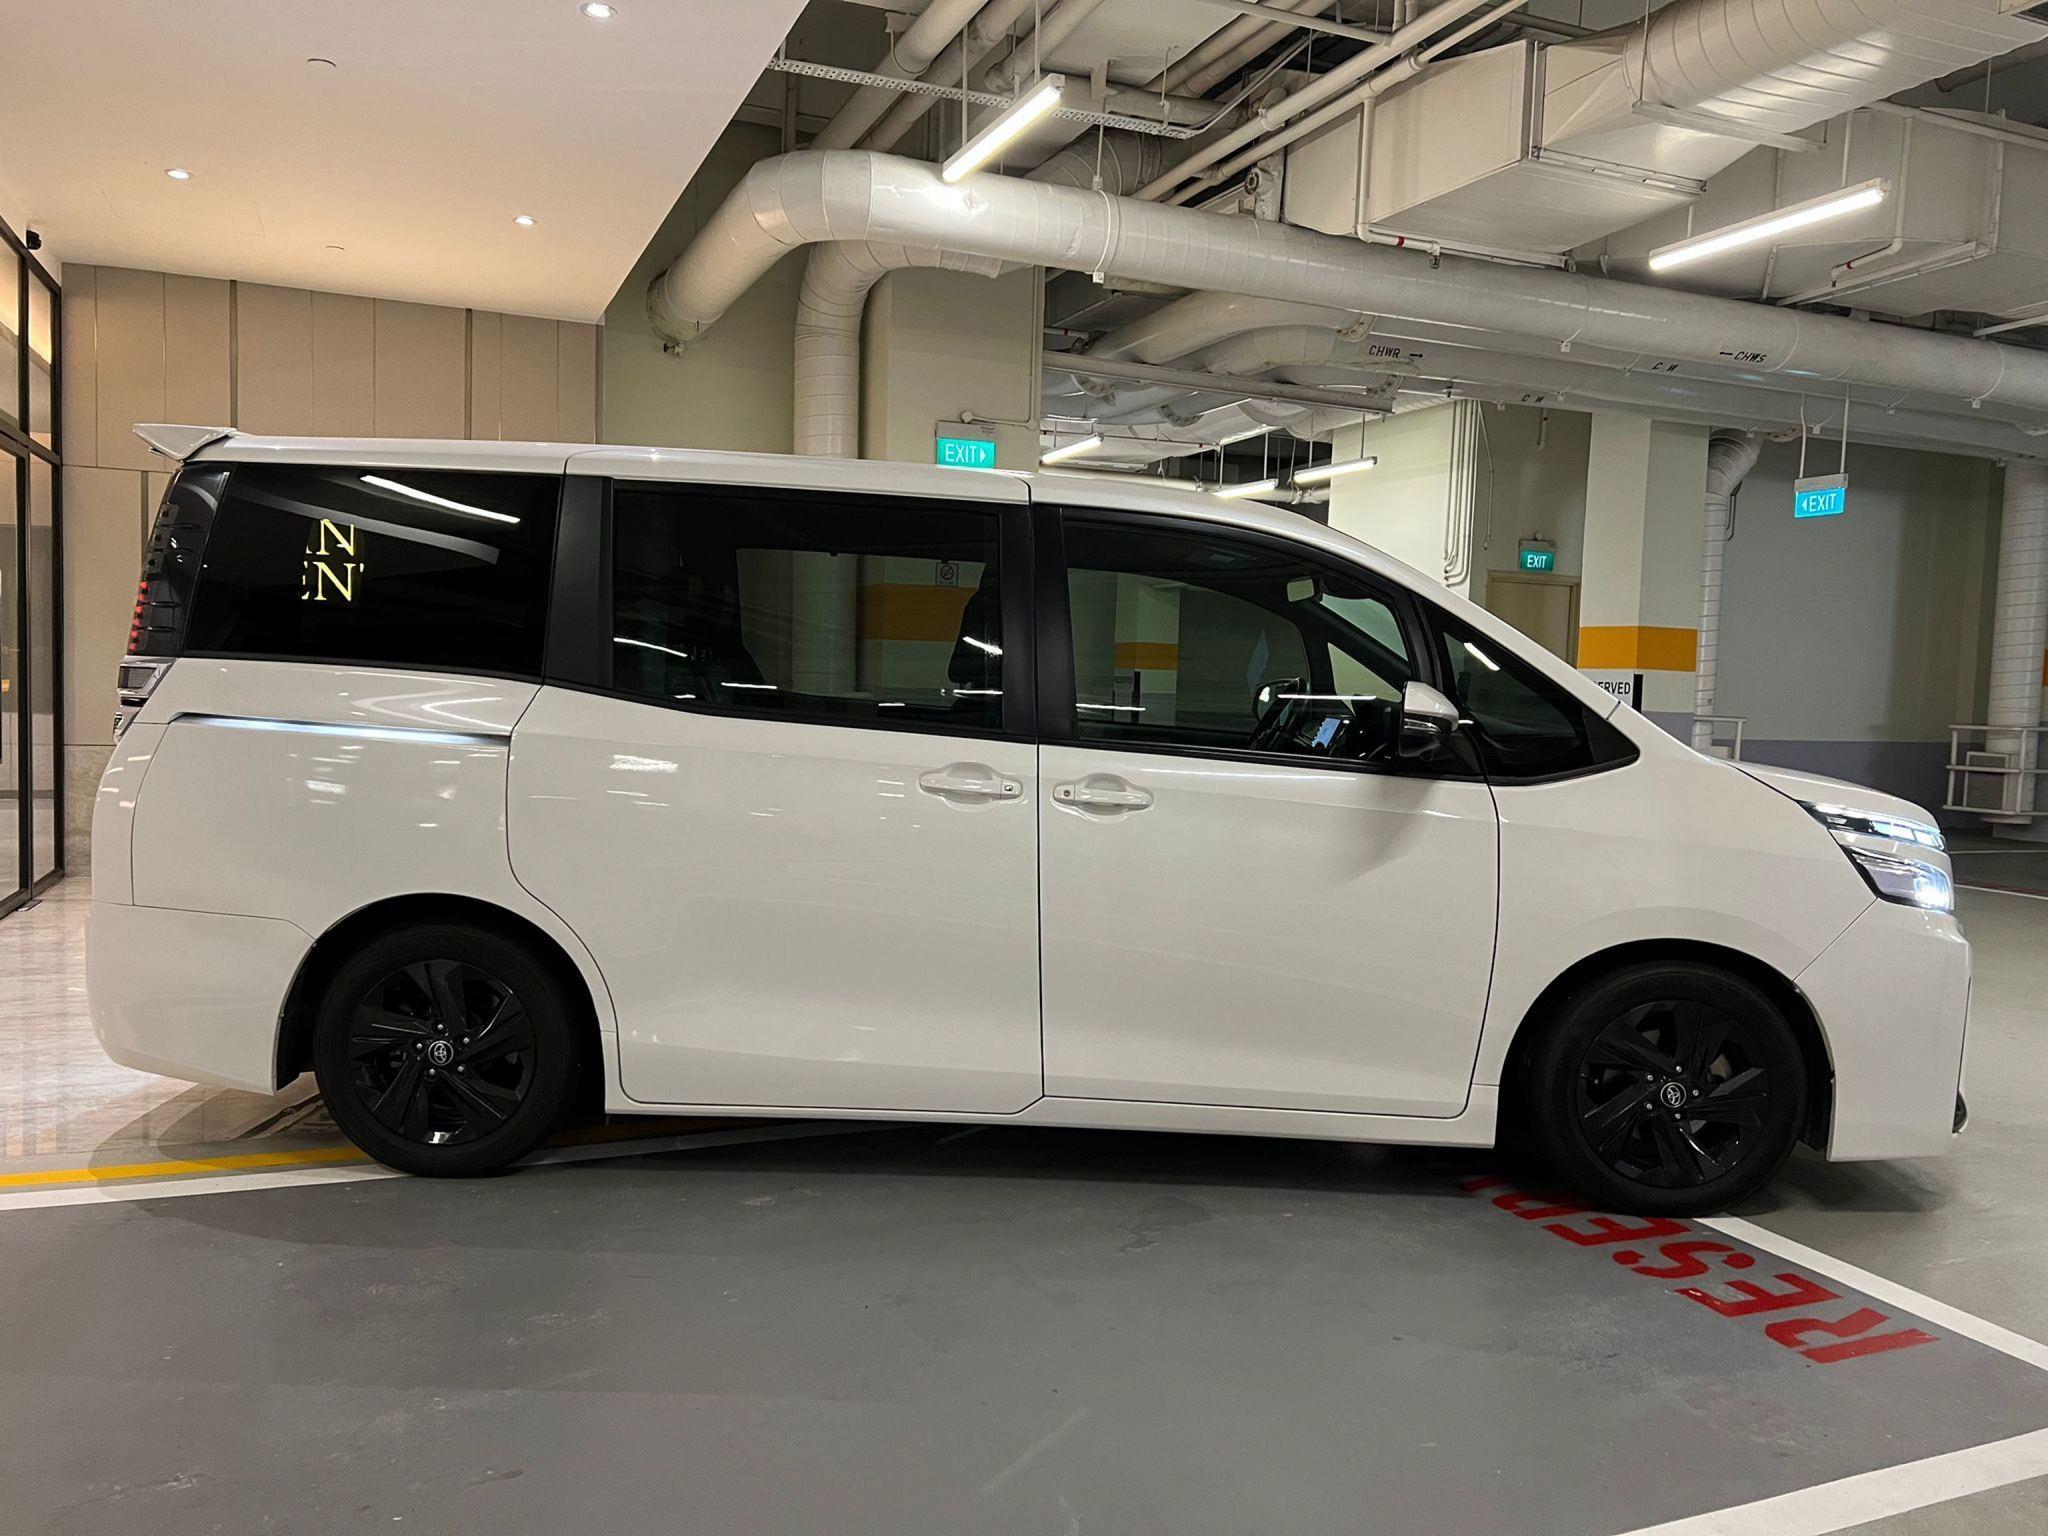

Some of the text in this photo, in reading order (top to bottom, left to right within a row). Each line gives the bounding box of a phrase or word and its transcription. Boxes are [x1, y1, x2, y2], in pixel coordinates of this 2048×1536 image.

[1369, 345, 1401, 358] CHWR
[1734, 351, 1766, 363] CHWS
[945, 443, 977, 463] EXIT
[1809, 494, 1837, 512] EXIT
[305, 519, 355, 556] N
[1527, 555, 1547, 568] EXIT
[1593, 681, 1631, 695] ERVED
